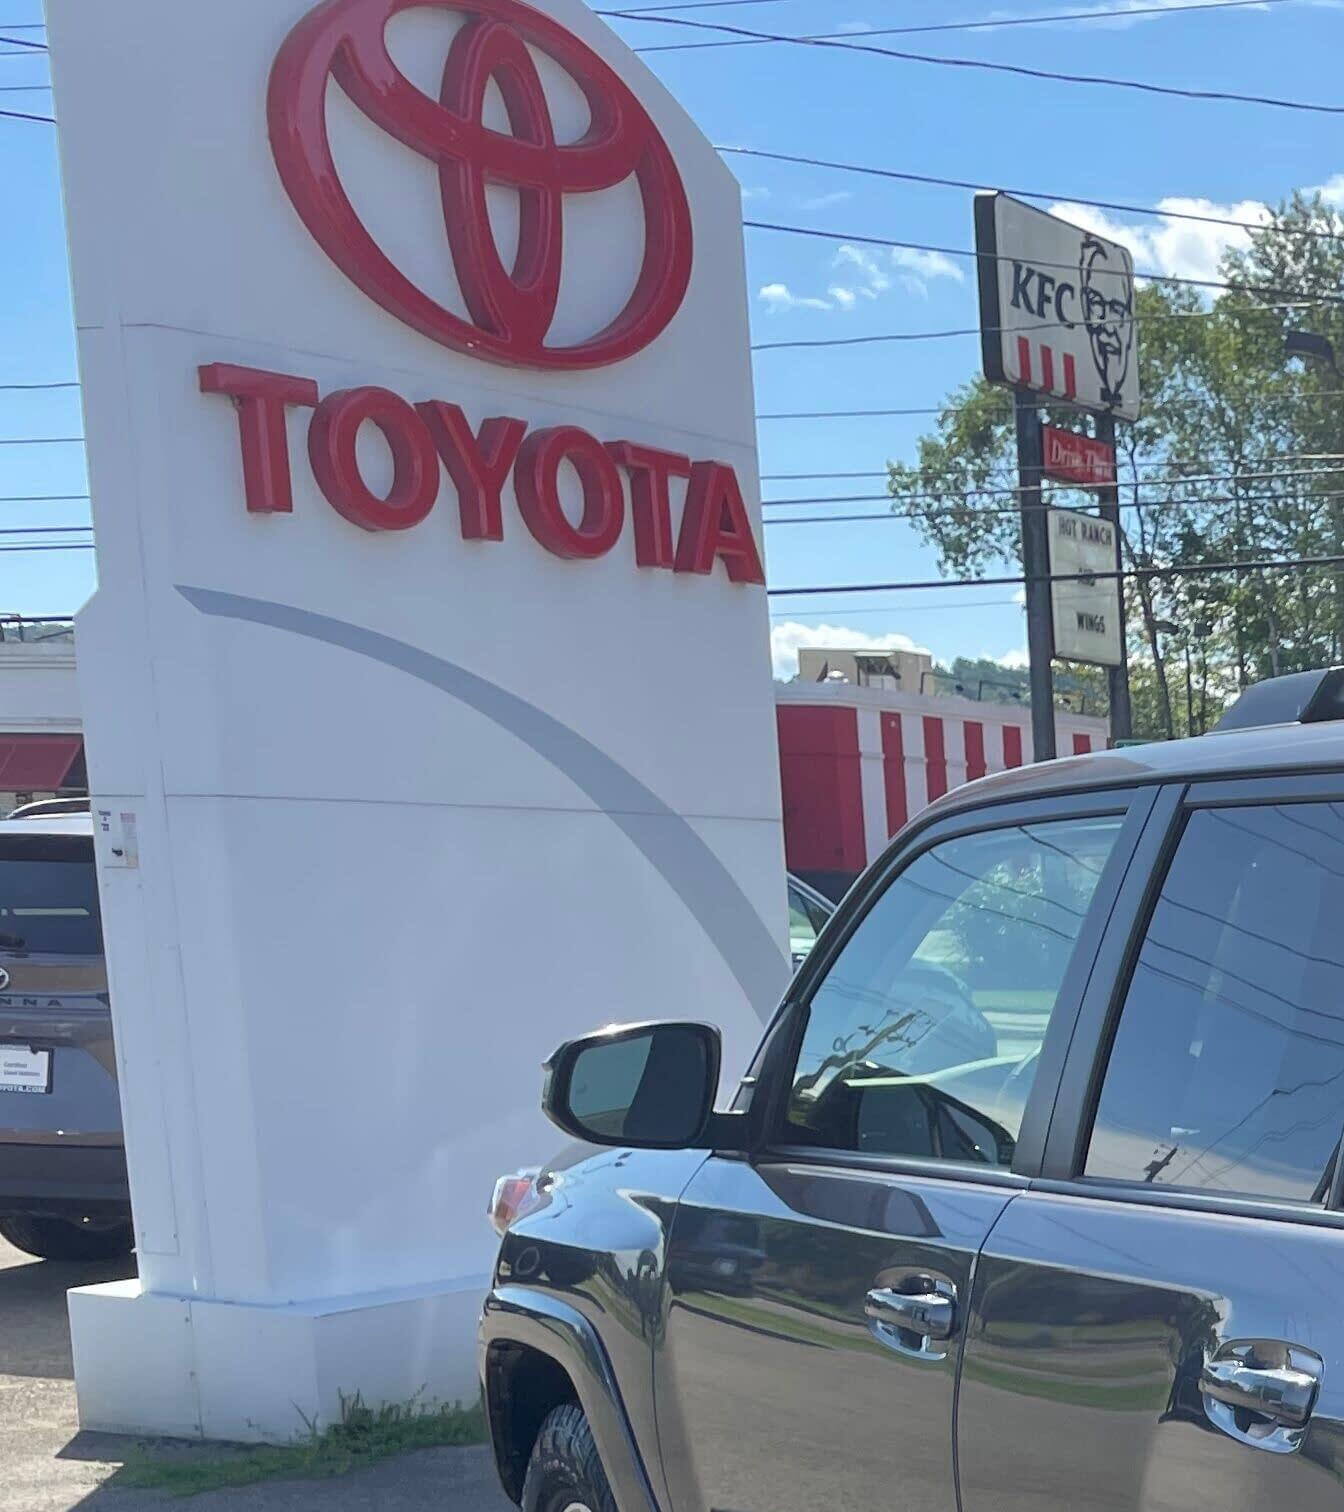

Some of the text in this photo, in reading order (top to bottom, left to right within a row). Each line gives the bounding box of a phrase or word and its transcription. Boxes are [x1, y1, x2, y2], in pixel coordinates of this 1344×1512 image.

[1010, 261, 1075, 331] KFC
[198, 362, 767, 586] TOYOTA
[1059, 516, 1112, 546] HOT RANCH
[1077, 612, 1105, 634] WINGS
